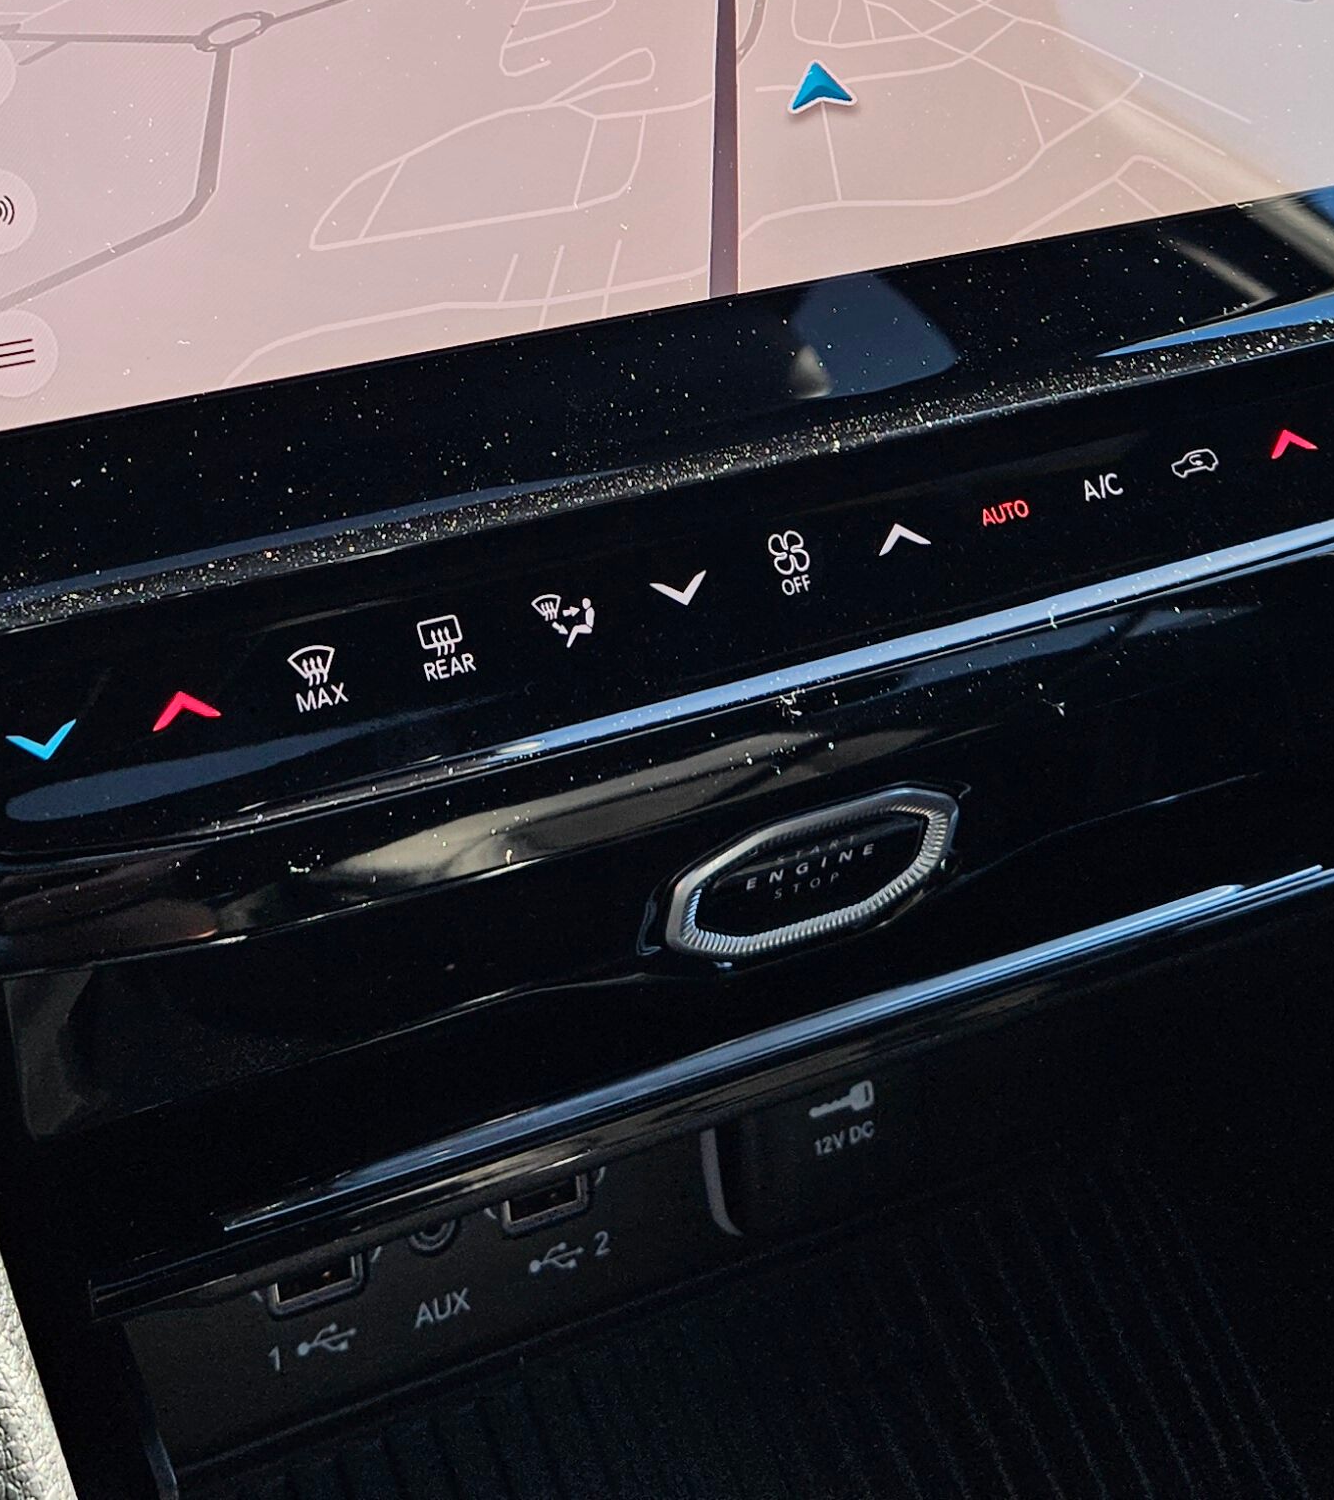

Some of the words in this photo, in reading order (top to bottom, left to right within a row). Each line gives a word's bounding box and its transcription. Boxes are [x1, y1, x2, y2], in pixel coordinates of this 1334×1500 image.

[1083, 472, 1124, 502] A/C
[981, 499, 1030, 527] AUTO
[780, 574, 812, 596] OFF
[423, 652, 477, 682] REAR
[294, 681, 349, 714] MAX
[745, 843, 876, 892] ENGINE
[773, 871, 840, 900] STOP
[814, 1129, 845, 1157] 12V
[848, 1120, 876, 1145] DC
[593, 1230, 613, 1258] 2
[414, 1287, 472, 1330] AUX
[267, 1345, 281, 1372] 1
